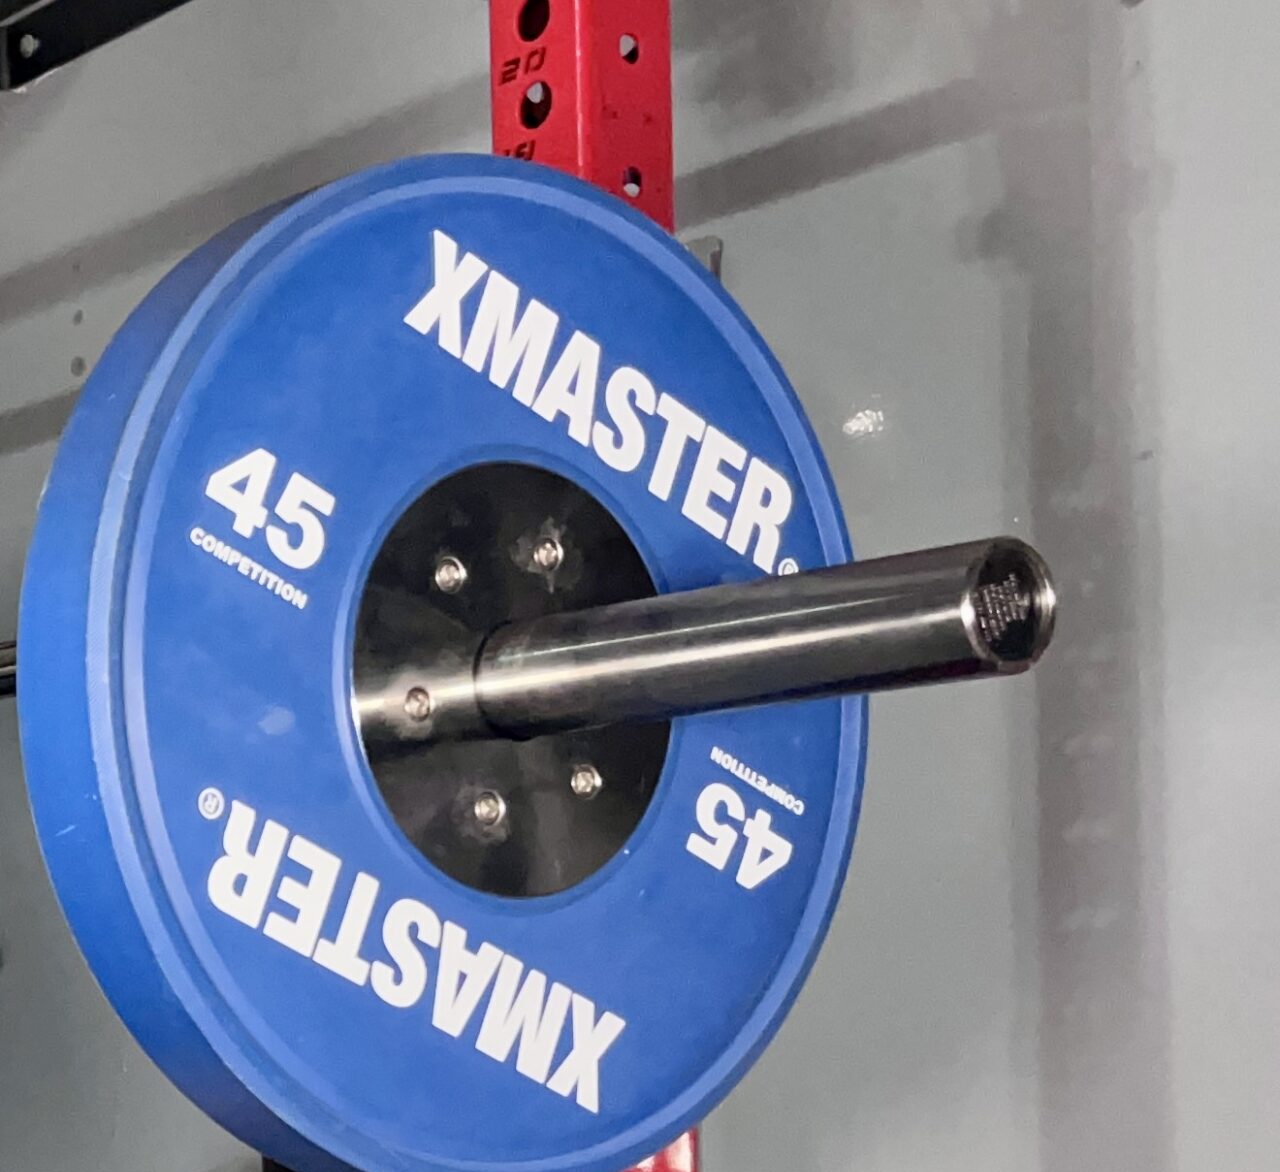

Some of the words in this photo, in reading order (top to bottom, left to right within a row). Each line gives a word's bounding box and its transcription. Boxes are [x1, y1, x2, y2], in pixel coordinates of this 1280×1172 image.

[205, 448, 336, 570] 45
[189, 526, 310, 610] COMPETITION
[710, 746, 805, 817] COMPETITION
[686, 783, 794, 890] 45
